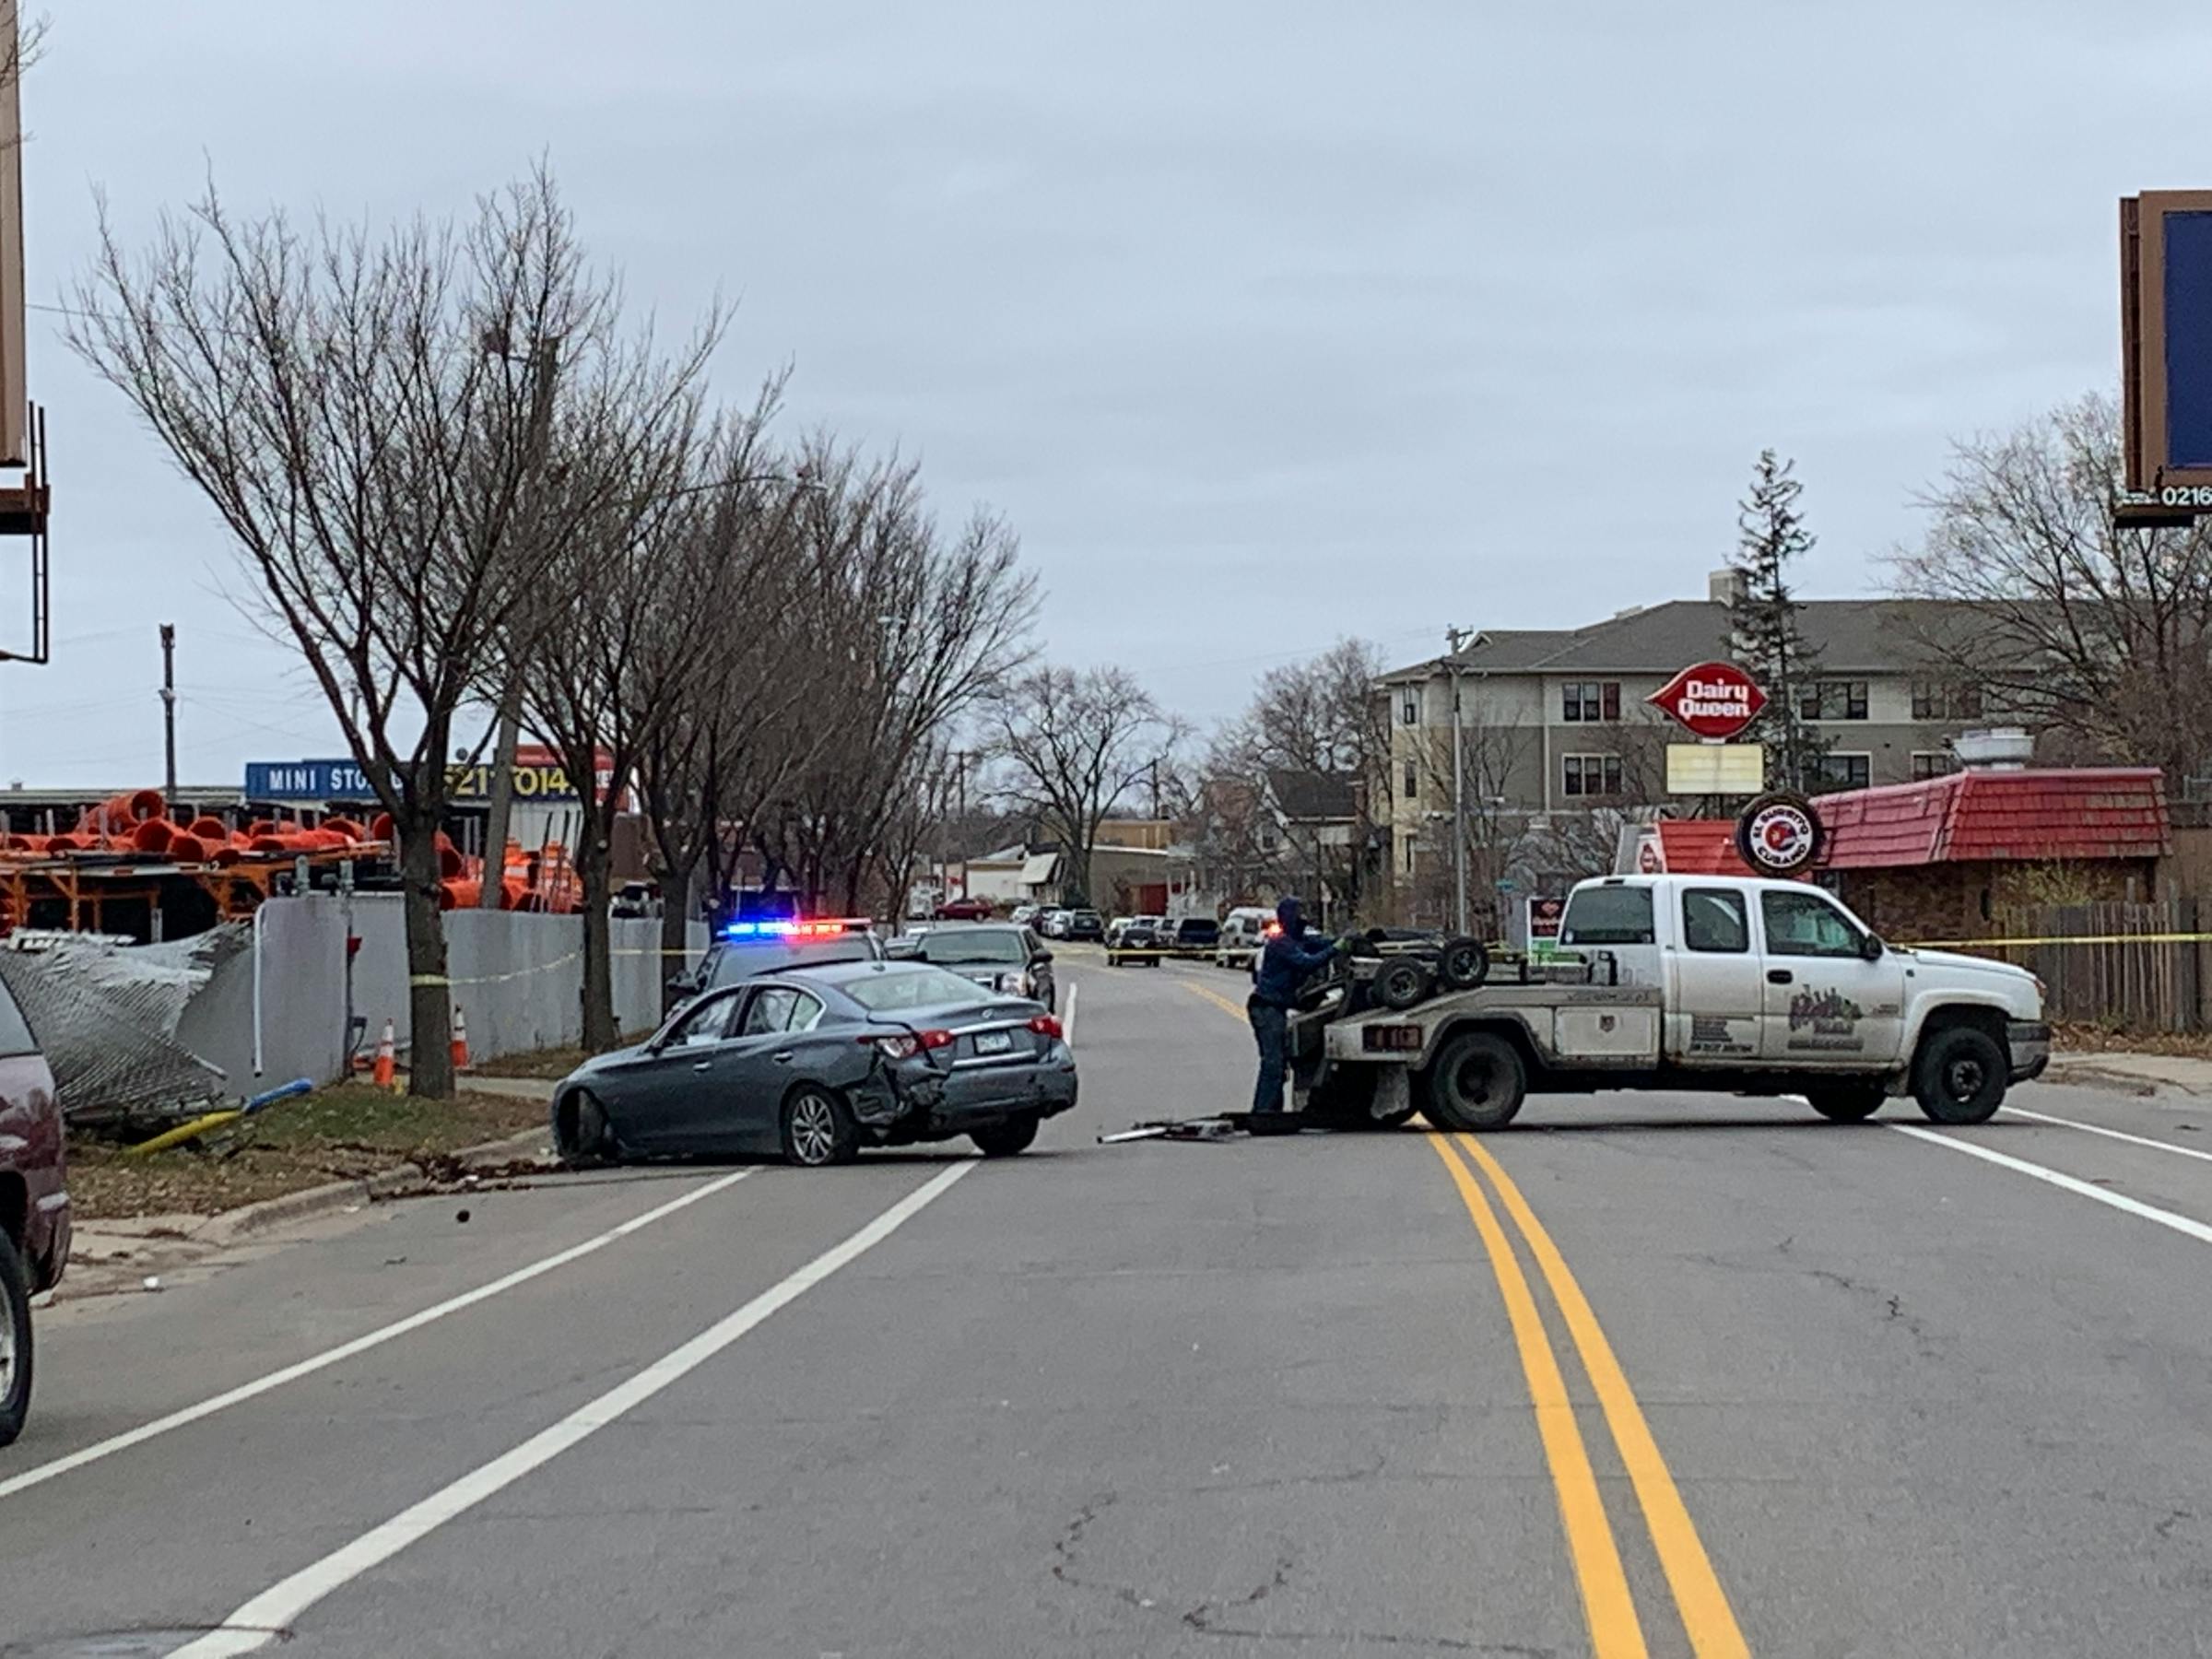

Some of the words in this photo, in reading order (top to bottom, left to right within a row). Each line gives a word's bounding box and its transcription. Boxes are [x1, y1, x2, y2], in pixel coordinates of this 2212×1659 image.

[2161, 487, 2212, 506] 0216
[1686, 678, 1749, 702] Dairy
[1678, 698, 1749, 721] Queen
[269, 769, 315, 791] MINI
